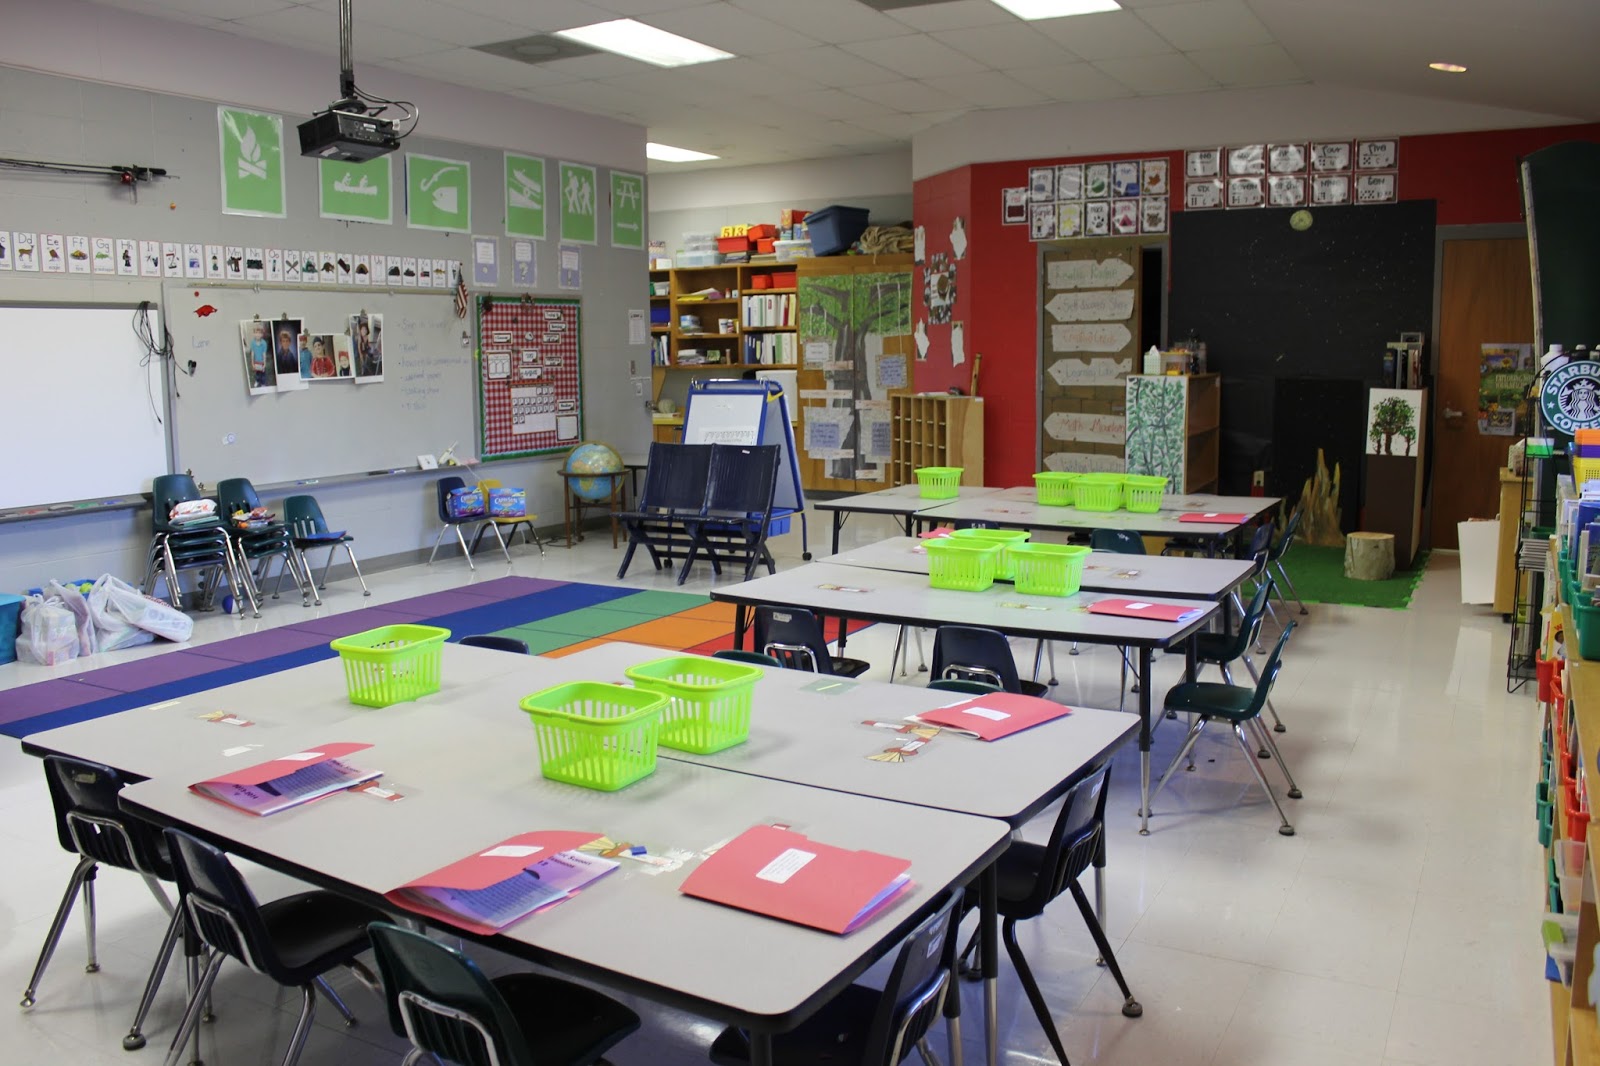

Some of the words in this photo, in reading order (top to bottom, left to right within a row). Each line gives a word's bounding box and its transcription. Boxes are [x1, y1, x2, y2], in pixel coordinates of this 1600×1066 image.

[1321, 144, 1342, 156] four
[1367, 143, 1387, 154] five
[1367, 176, 1385, 185] ten
[1197, 185, 1210, 193] six
[18, 232, 33, 245] Dd
[46, 234, 59, 246] Ee
[96, 239, 110, 251] Gg
[1547, 364, 1600, 396] STARBU
[1553, 413, 1600, 432] COFFE
